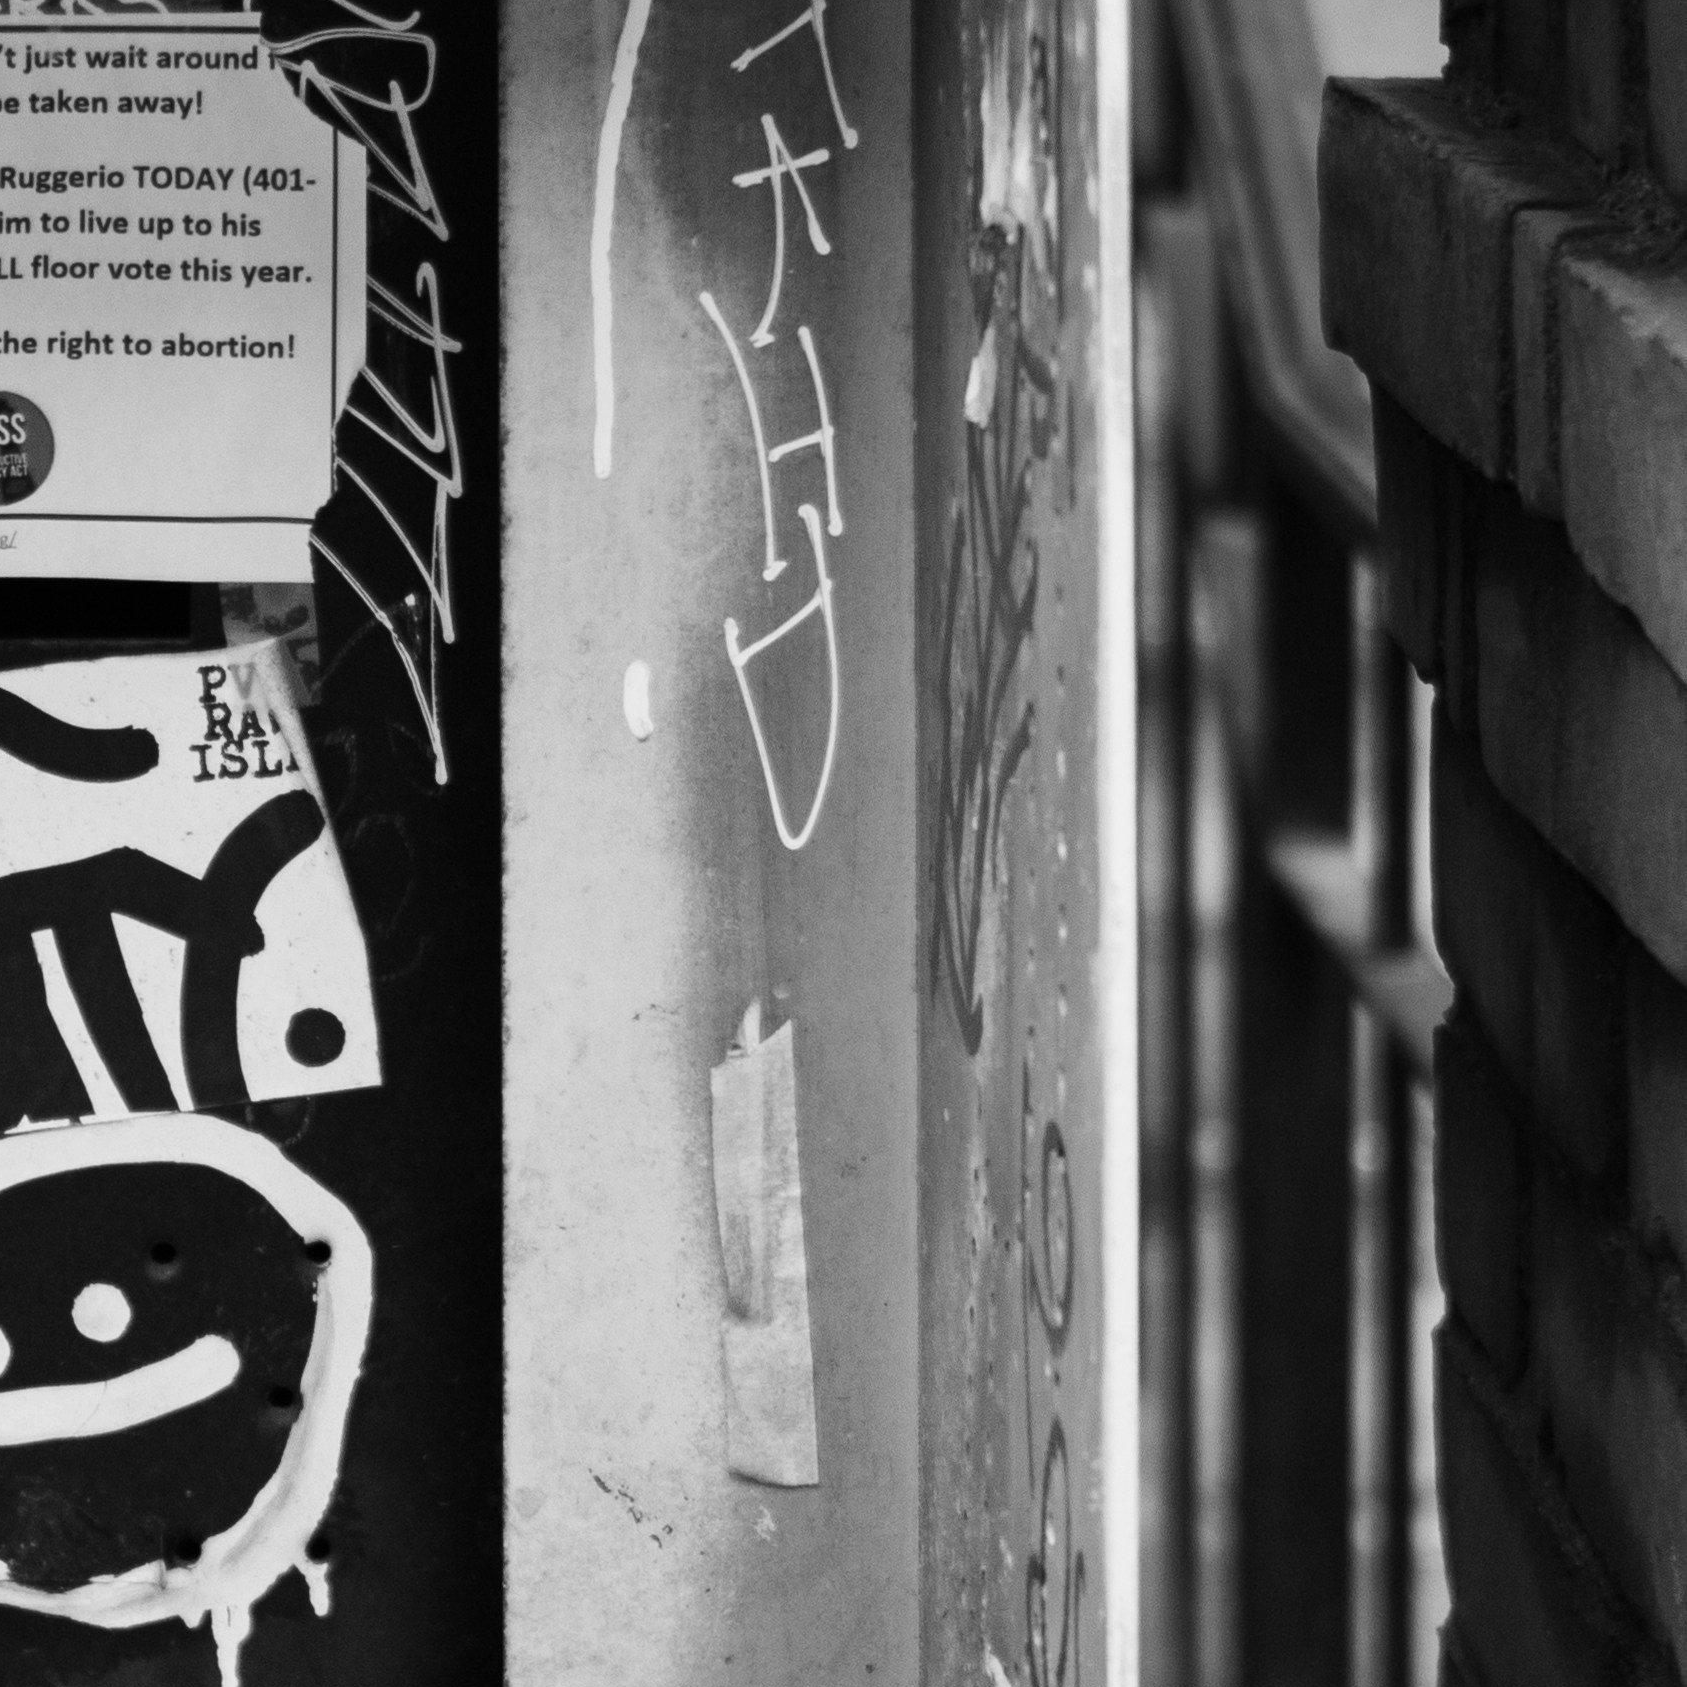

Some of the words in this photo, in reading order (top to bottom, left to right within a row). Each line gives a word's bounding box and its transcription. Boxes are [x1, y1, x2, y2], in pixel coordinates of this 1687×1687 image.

[22, 44, 77, 75] just
[84, 44, 148, 69] wait
[155, 45, 259, 71] around
[28, 88, 109, 115] taken
[116, 90, 203, 121] away!
[132, 164, 235, 192] TODAY
[242, 165, 317, 197] (401-
[39, 212, 71, 234] to
[79, 208, 129, 235] live
[138, 216, 175, 241] up
[181, 214, 213, 237] to
[221, 211, 262, 238] his
[30, 253, 101, 280] floor
[107, 258, 173, 281] vote
[179, 256, 233, 283] this
[240, 265, 313, 289] year.
[47, 329, 115, 361] right
[121, 333, 153, 356] to
[161, 331, 295, 359] abortion!
[10, 463, 28, 478] ACT
